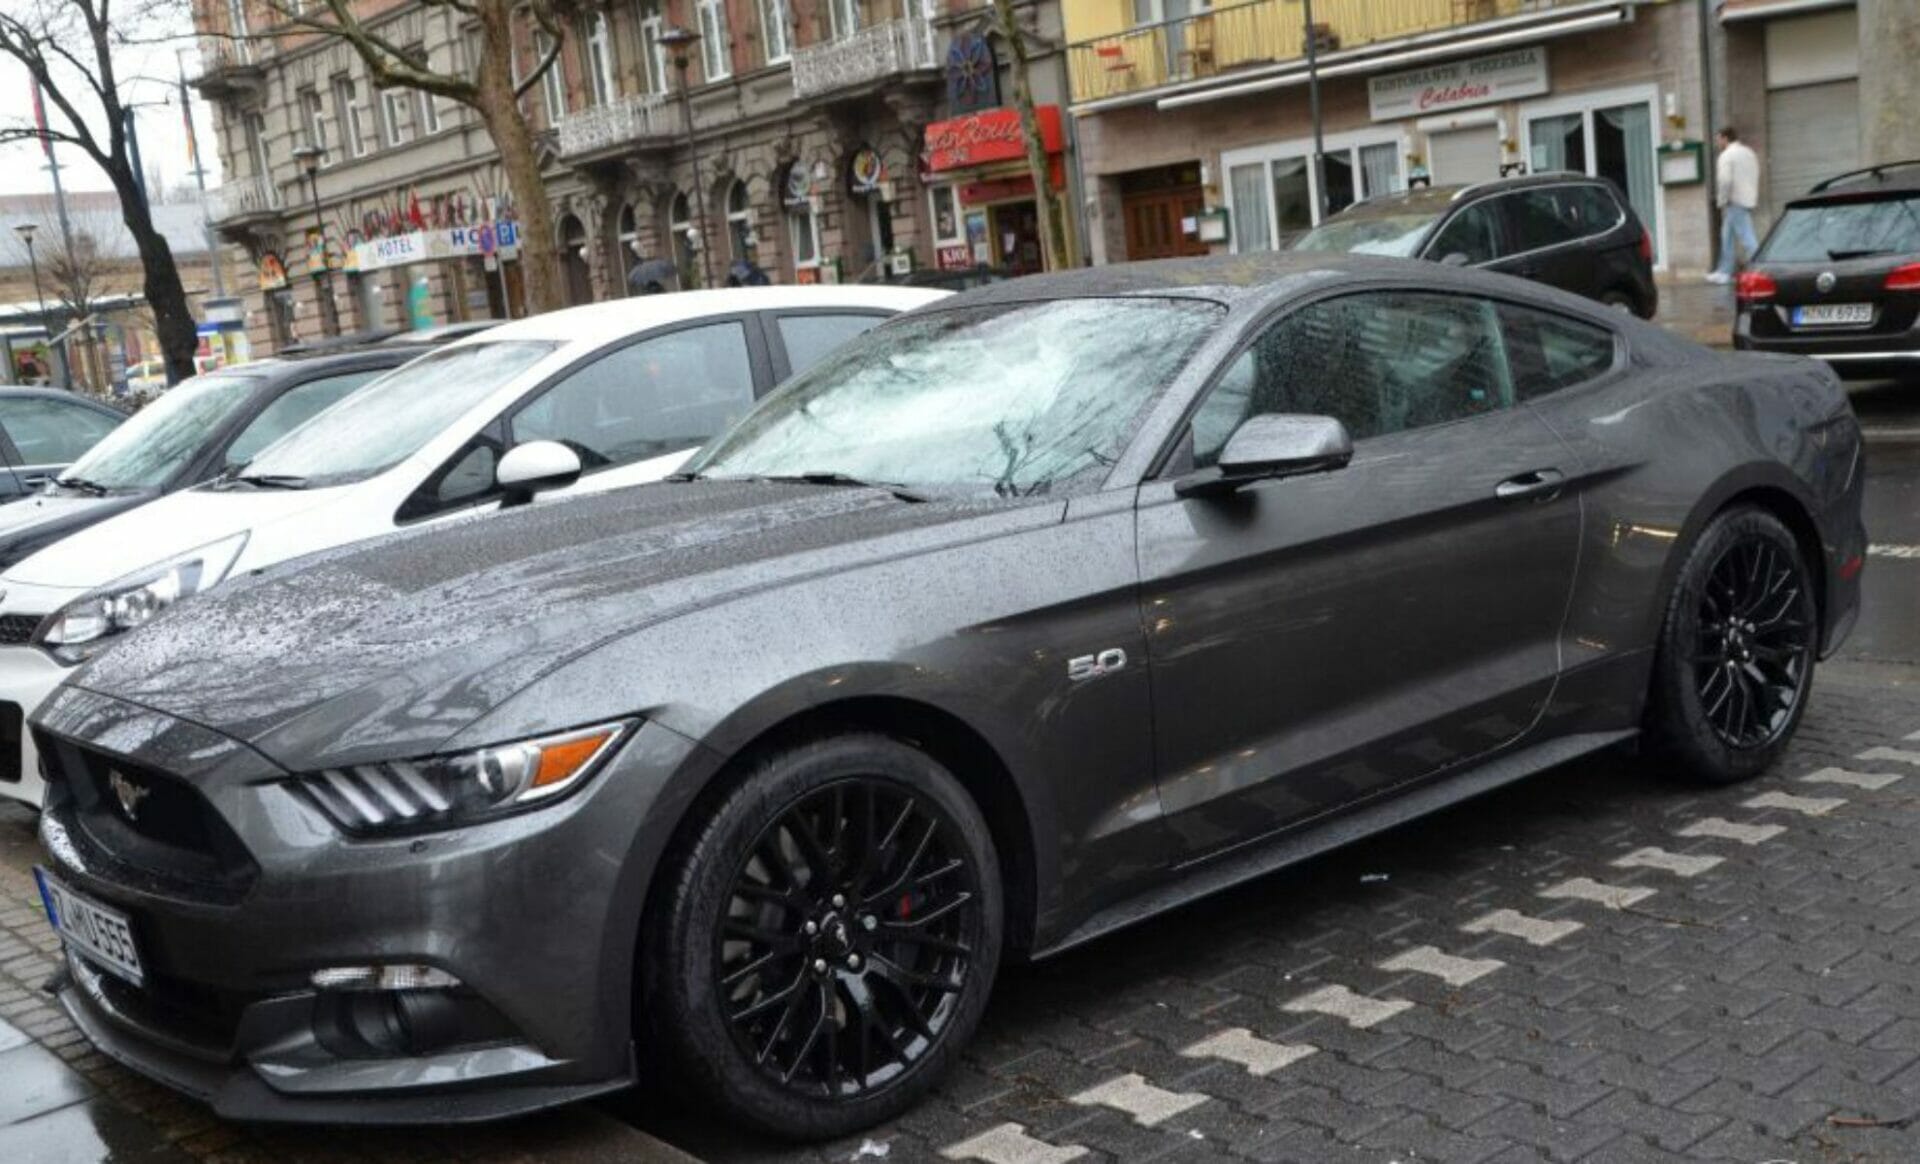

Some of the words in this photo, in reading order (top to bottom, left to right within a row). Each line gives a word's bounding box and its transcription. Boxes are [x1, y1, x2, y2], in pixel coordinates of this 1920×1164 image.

[1373, 67, 1458, 92] RISTORANTE
[1419, 79, 1490, 110] Calabria
[377, 237, 414, 258] HOTEL
